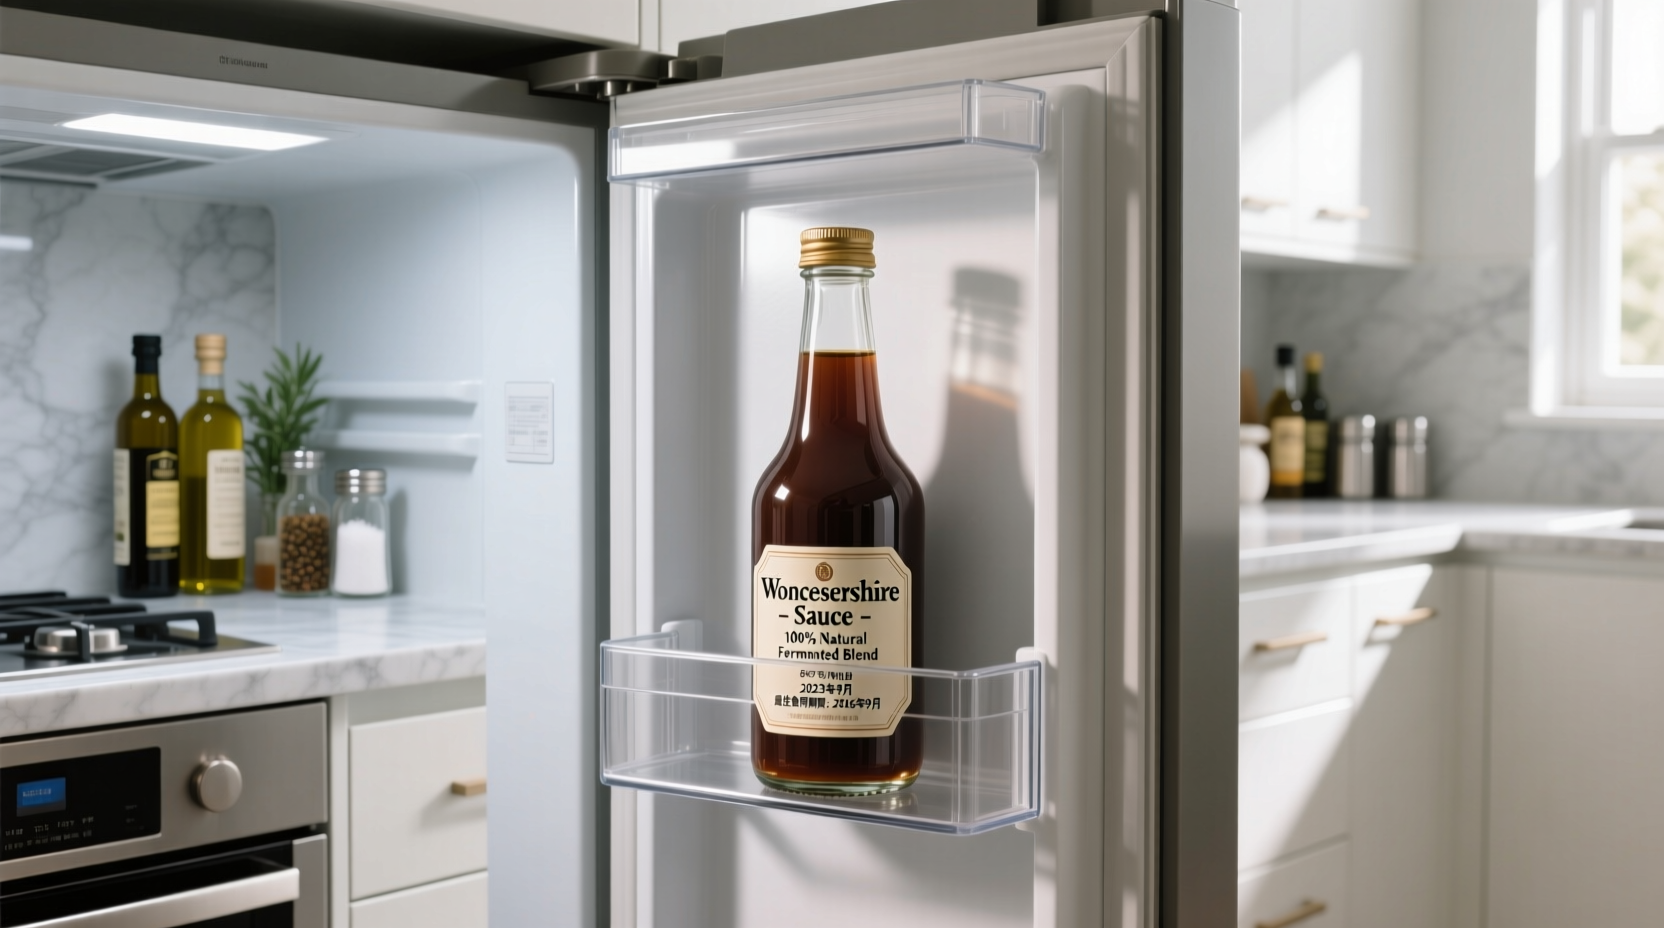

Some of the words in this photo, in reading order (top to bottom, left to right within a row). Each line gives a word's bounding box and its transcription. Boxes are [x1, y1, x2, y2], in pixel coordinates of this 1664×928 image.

[761, 577, 900, 602] Woncesershire
[794, 605, 854, 626] Sauce
[785, 631, 817, 645] 100%
[820, 631, 867, 645] Natural
[843, 647, 878, 661] Blend
